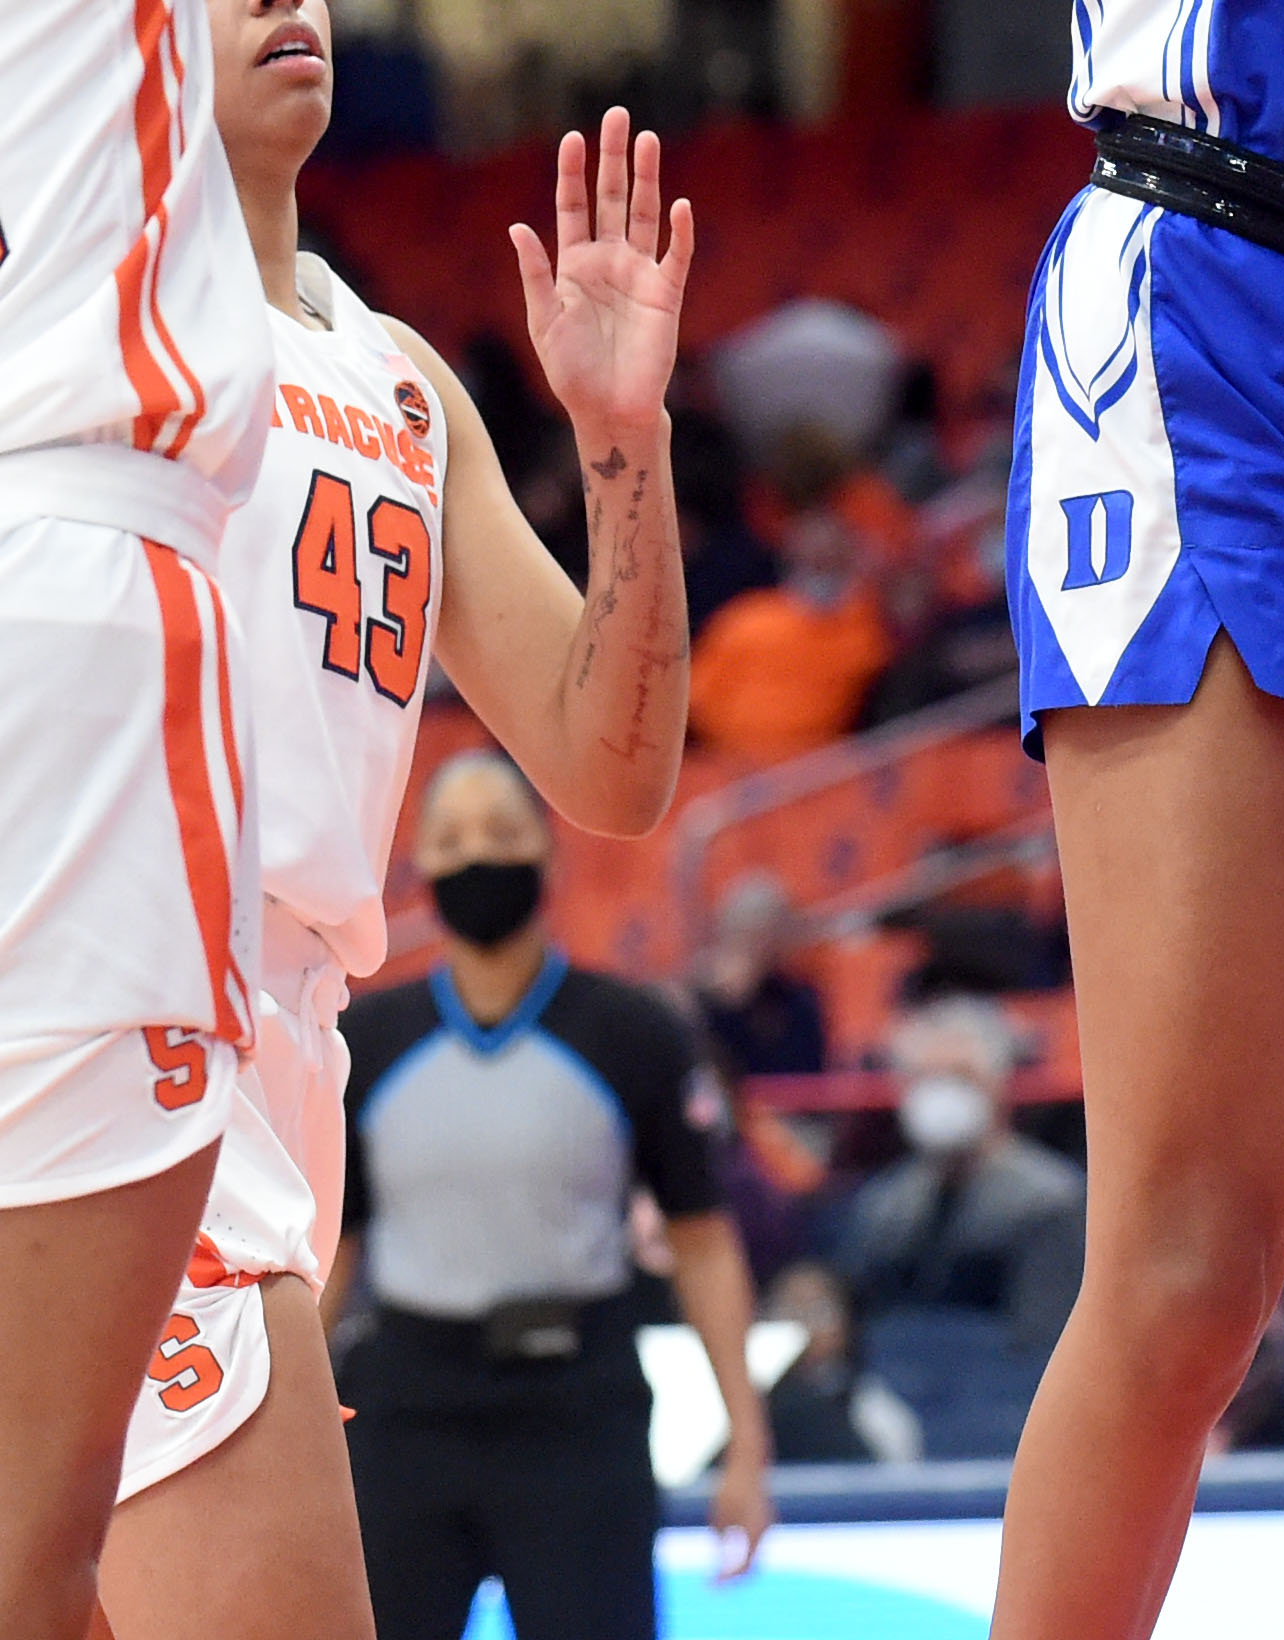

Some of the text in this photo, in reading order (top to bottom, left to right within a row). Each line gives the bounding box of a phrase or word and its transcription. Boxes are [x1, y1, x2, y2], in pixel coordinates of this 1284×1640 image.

[271, 384, 438, 508] RACUSE
[292, 468, 431, 709] 43
[1059, 489, 1134, 591] D
[142, 1024, 209, 1111] S
[148, 1314, 225, 1412] S
